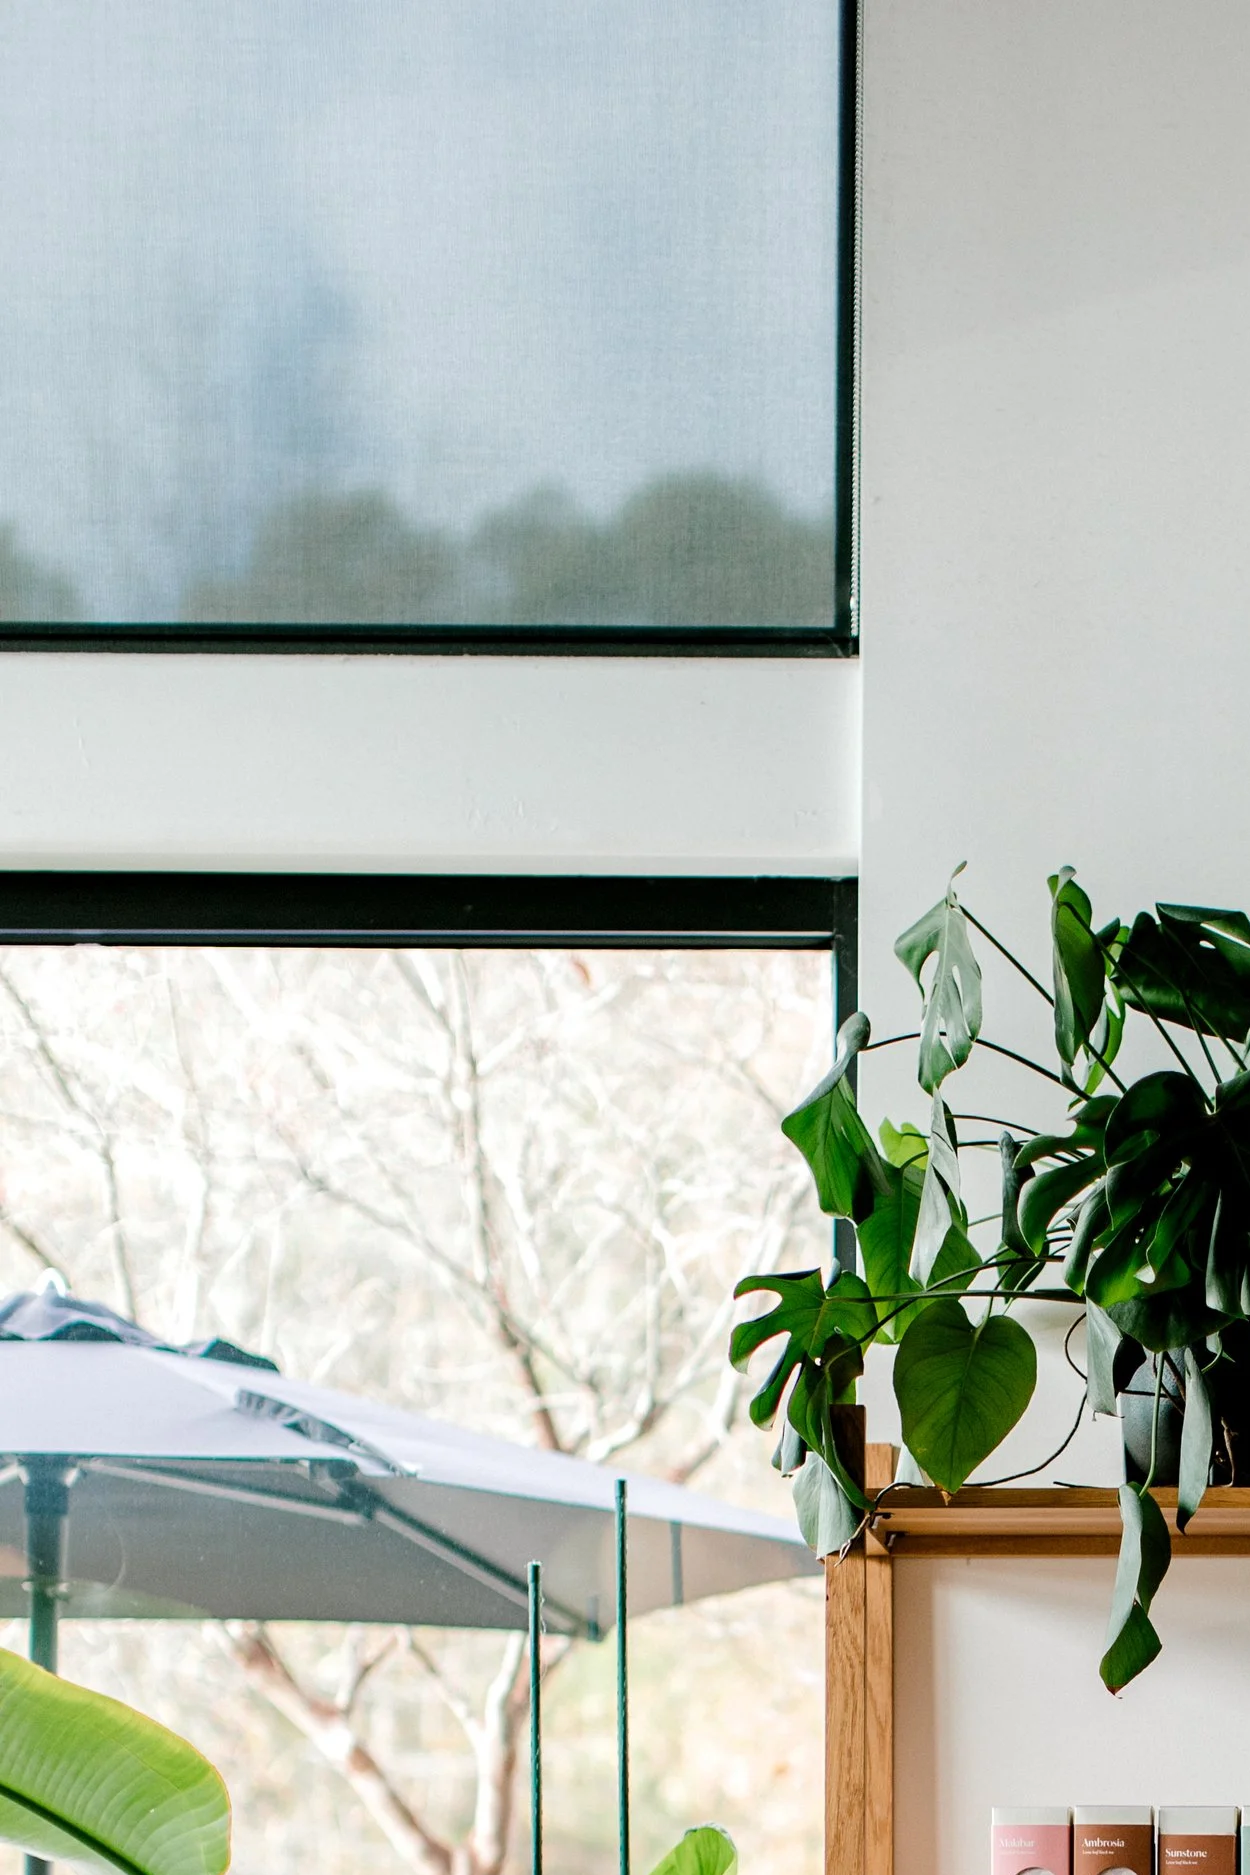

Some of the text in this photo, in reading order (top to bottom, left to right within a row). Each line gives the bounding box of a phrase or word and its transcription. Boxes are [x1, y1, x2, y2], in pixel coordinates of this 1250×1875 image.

[999, 1838, 1035, 1847] Malabar
[1082, 1837, 1125, 1848] Ambrosia
[1165, 1848, 1208, 1858] Sunstone
